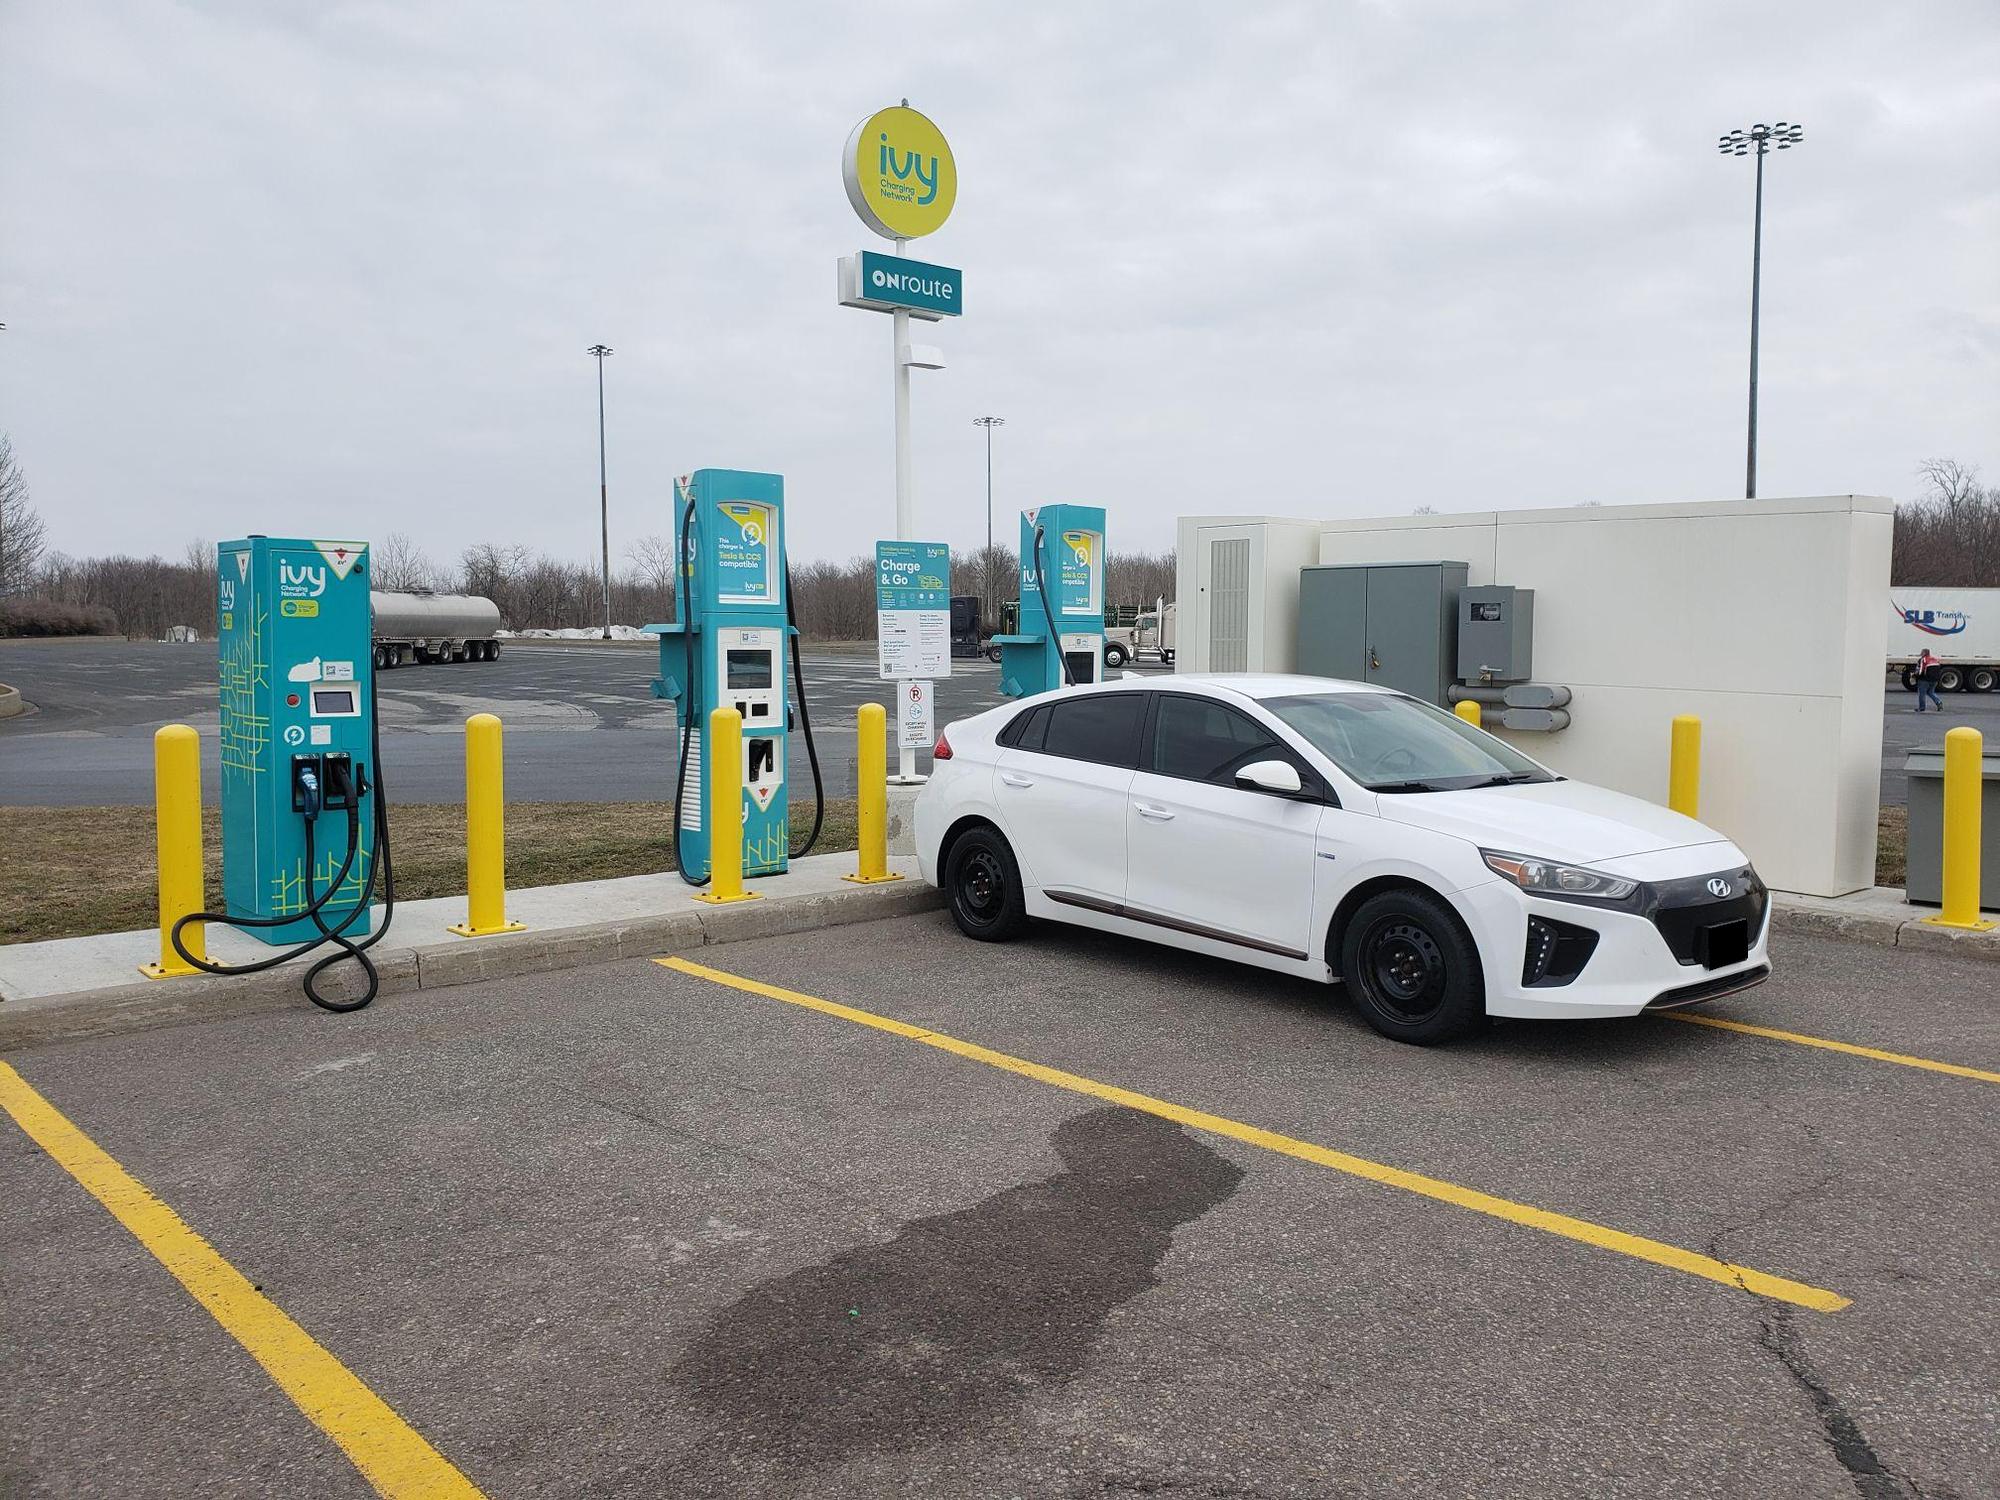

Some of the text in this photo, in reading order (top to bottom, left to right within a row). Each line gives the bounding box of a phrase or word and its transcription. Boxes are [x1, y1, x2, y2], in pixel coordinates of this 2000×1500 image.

[880, 133, 938, 205] ivy
[880, 178, 915, 196] Charging
[880, 188, 913, 203] Network
[872, 270, 953, 299] ONroute
[719, 560, 759, 569] compatible
[880, 559, 921, 574] Charge
[280, 558, 326, 597] ivy
[881, 573, 909, 585] & Go
[221, 574, 235, 610] ivy
[280, 585, 309, 593] Charging
[1903, 609, 1936, 624] SLB
